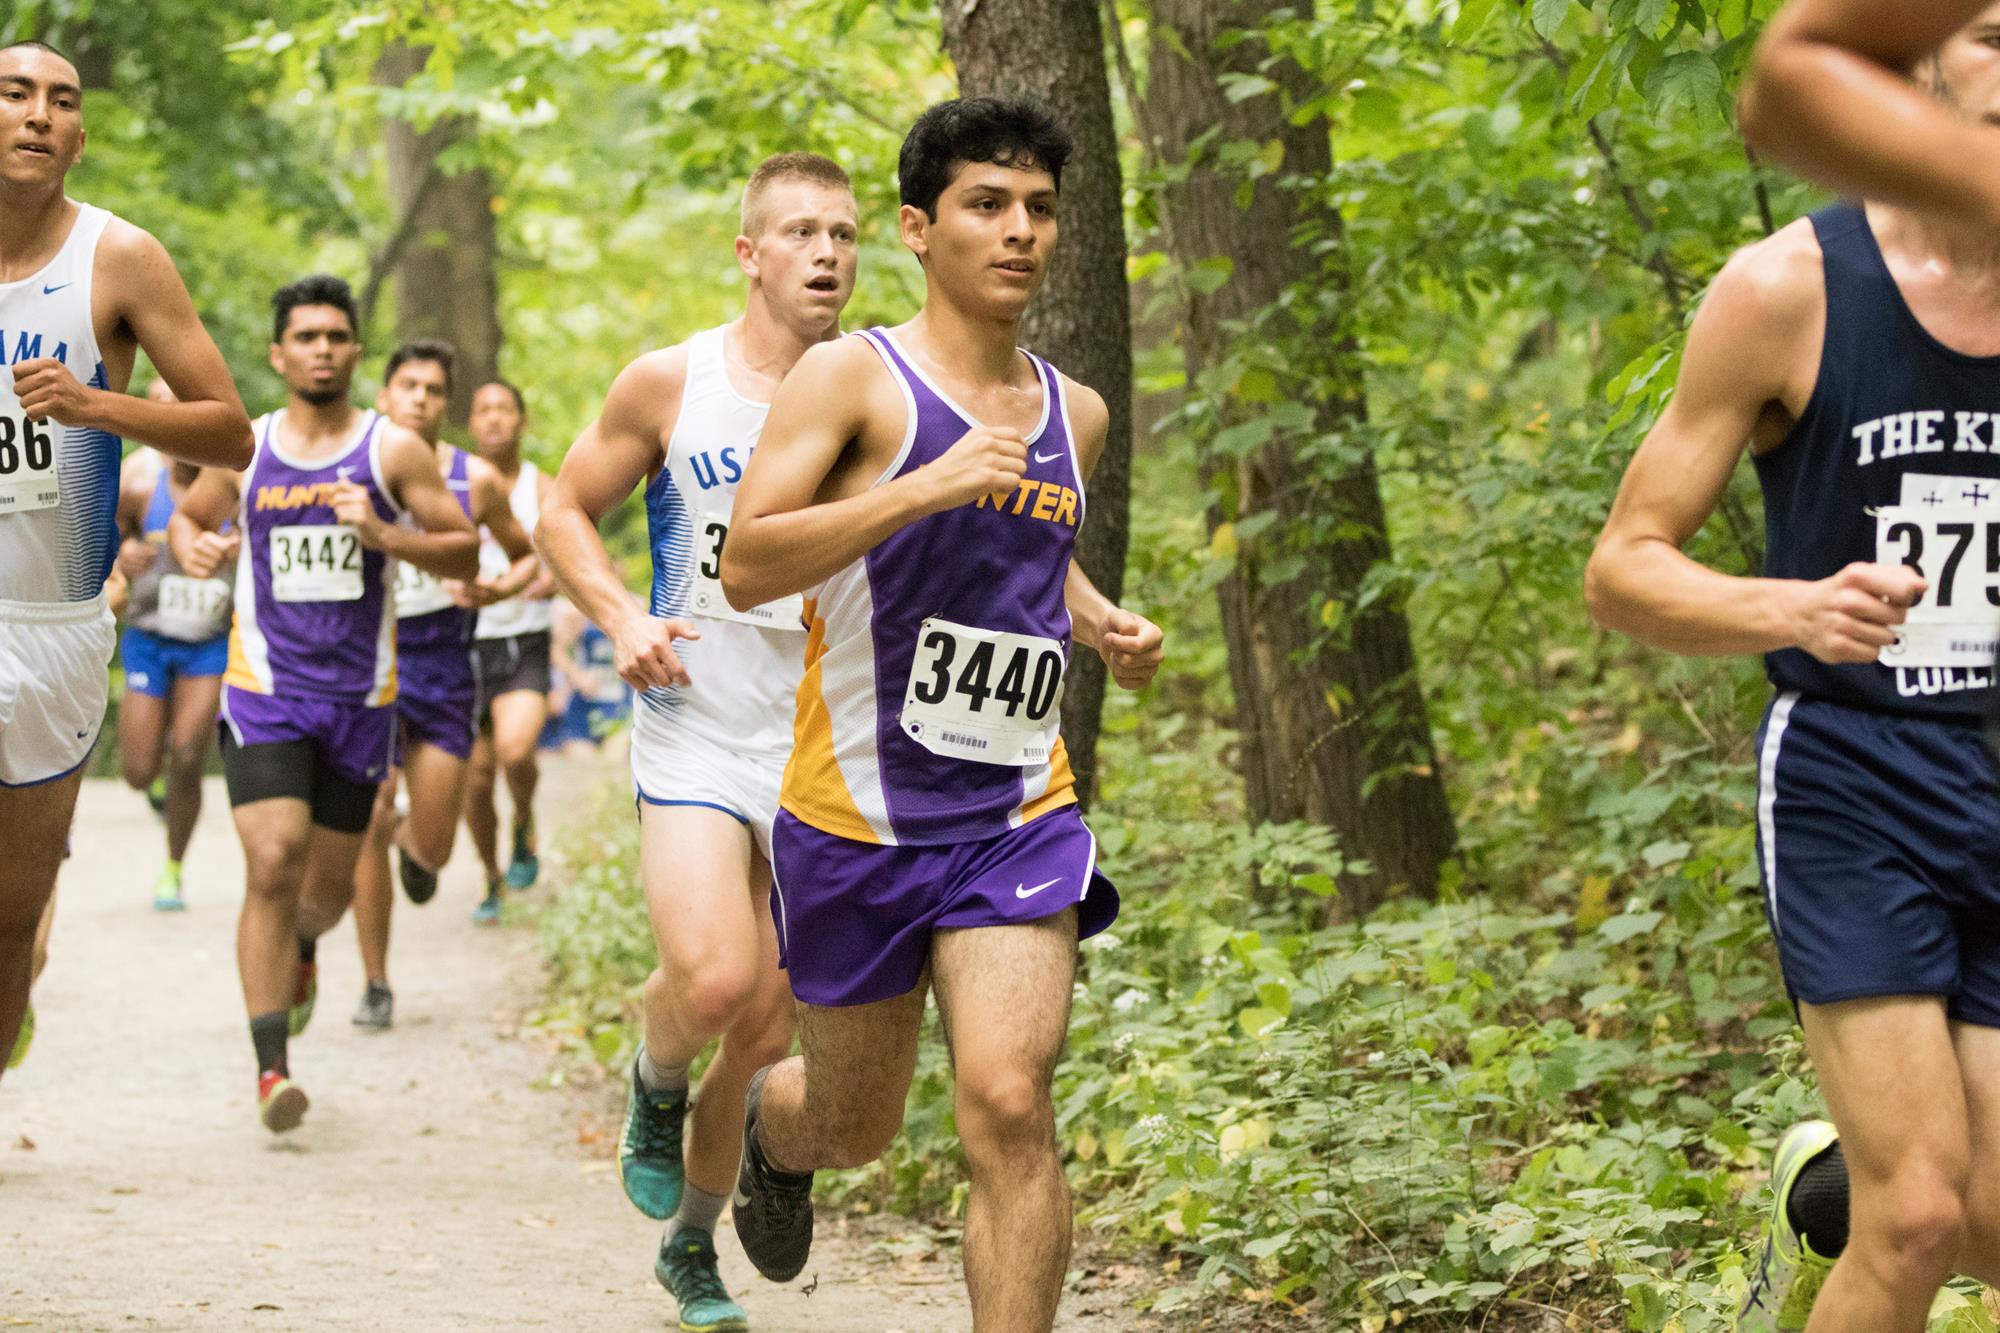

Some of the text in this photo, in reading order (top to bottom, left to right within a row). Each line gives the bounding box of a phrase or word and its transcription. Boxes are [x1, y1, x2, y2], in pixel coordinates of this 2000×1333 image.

[1852, 410, 1944, 466] THE
[689, 447, 754, 490] US
[975, 478, 1078, 526] NTER
[278, 532, 362, 574] 3442
[914, 631, 1059, 722] 3440
